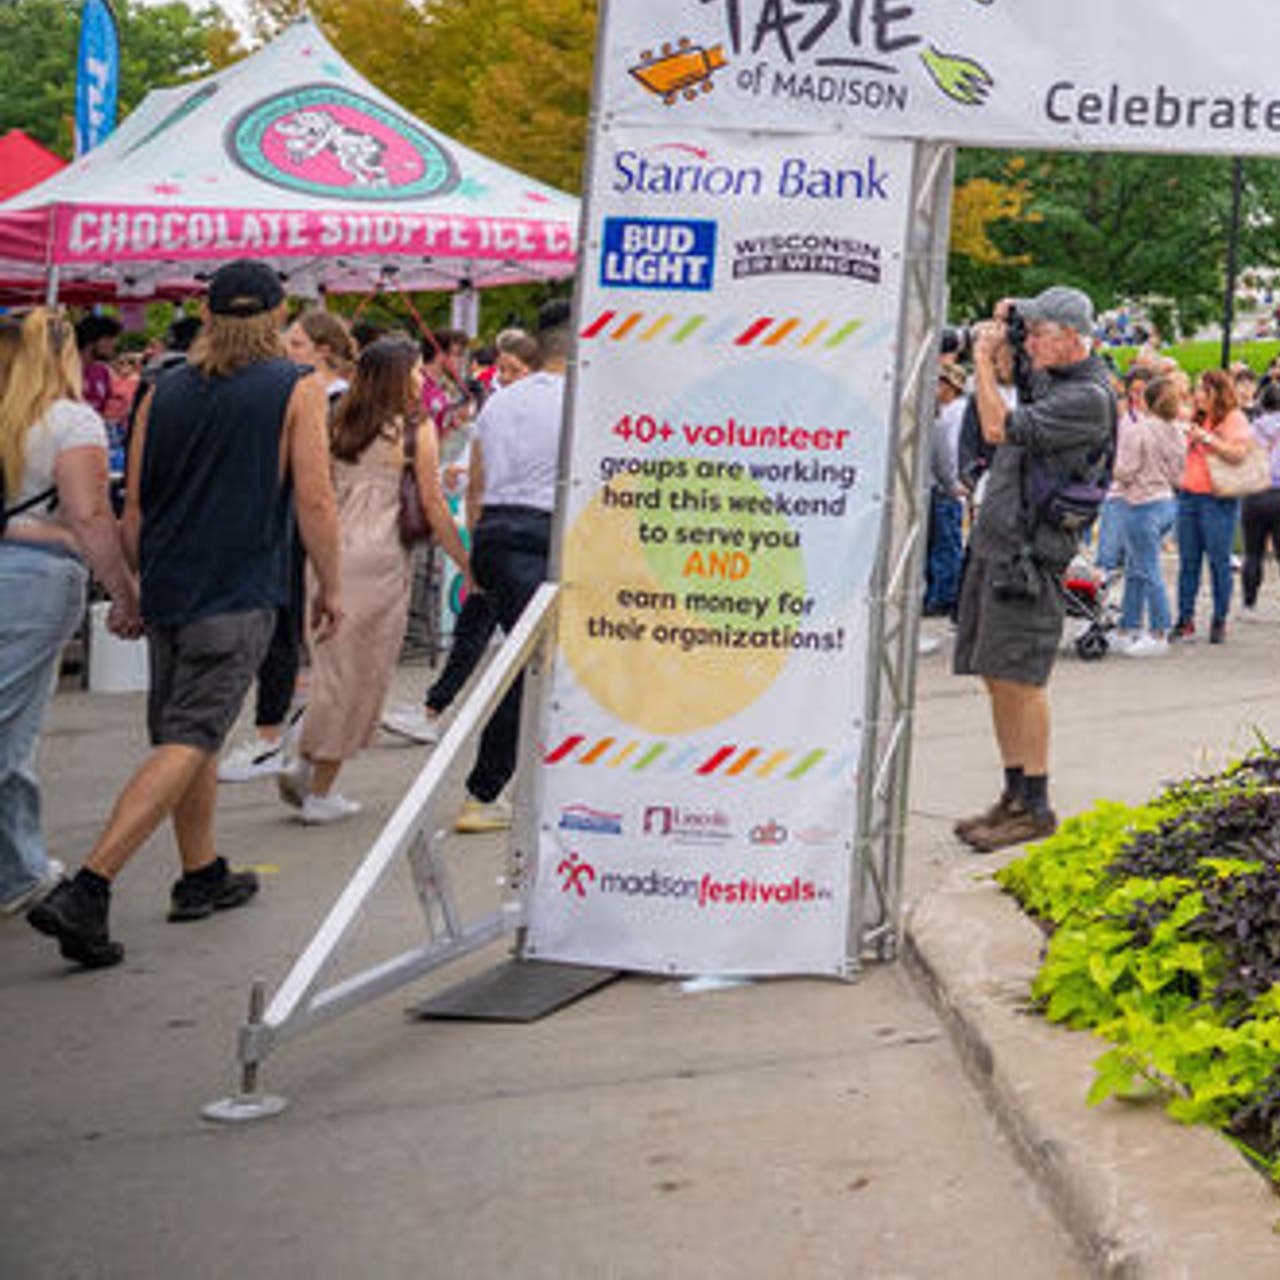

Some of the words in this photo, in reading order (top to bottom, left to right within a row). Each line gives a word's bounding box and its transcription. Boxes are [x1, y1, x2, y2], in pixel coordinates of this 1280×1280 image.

[738, 63, 767, 95] of
[772, 71, 908, 110] MADISON
[612, 150, 761, 197] Starion
[778, 154, 890, 200] Bank
[68, 210, 310, 255] CHOCOLATE
[621, 223, 695, 252] BUD
[735, 233, 880, 260] WISCONSIN
[604, 253, 711, 284] LIGHT
[612, 415, 675, 445] 40+
[683, 418, 851, 450] volunteer
[600, 456, 689, 481] groups
[698, 458, 745, 481] are
[750, 459, 857, 491] working
[602, 485, 661, 511] hard
[669, 488, 722, 513] this
[729, 491, 847, 517] weekend
[639, 519, 668, 543] to
[675, 526, 744, 545] serve
[749, 529, 801, 553] you
[681, 551, 751, 581] AND
[617, 591, 677, 612] earn
[684, 593, 770, 620] money
[778, 592, 816, 616] for
[588, 618, 646, 641] their
[652, 622, 845, 653] organizations!
[600, 870, 816, 907] madisonfestivals
